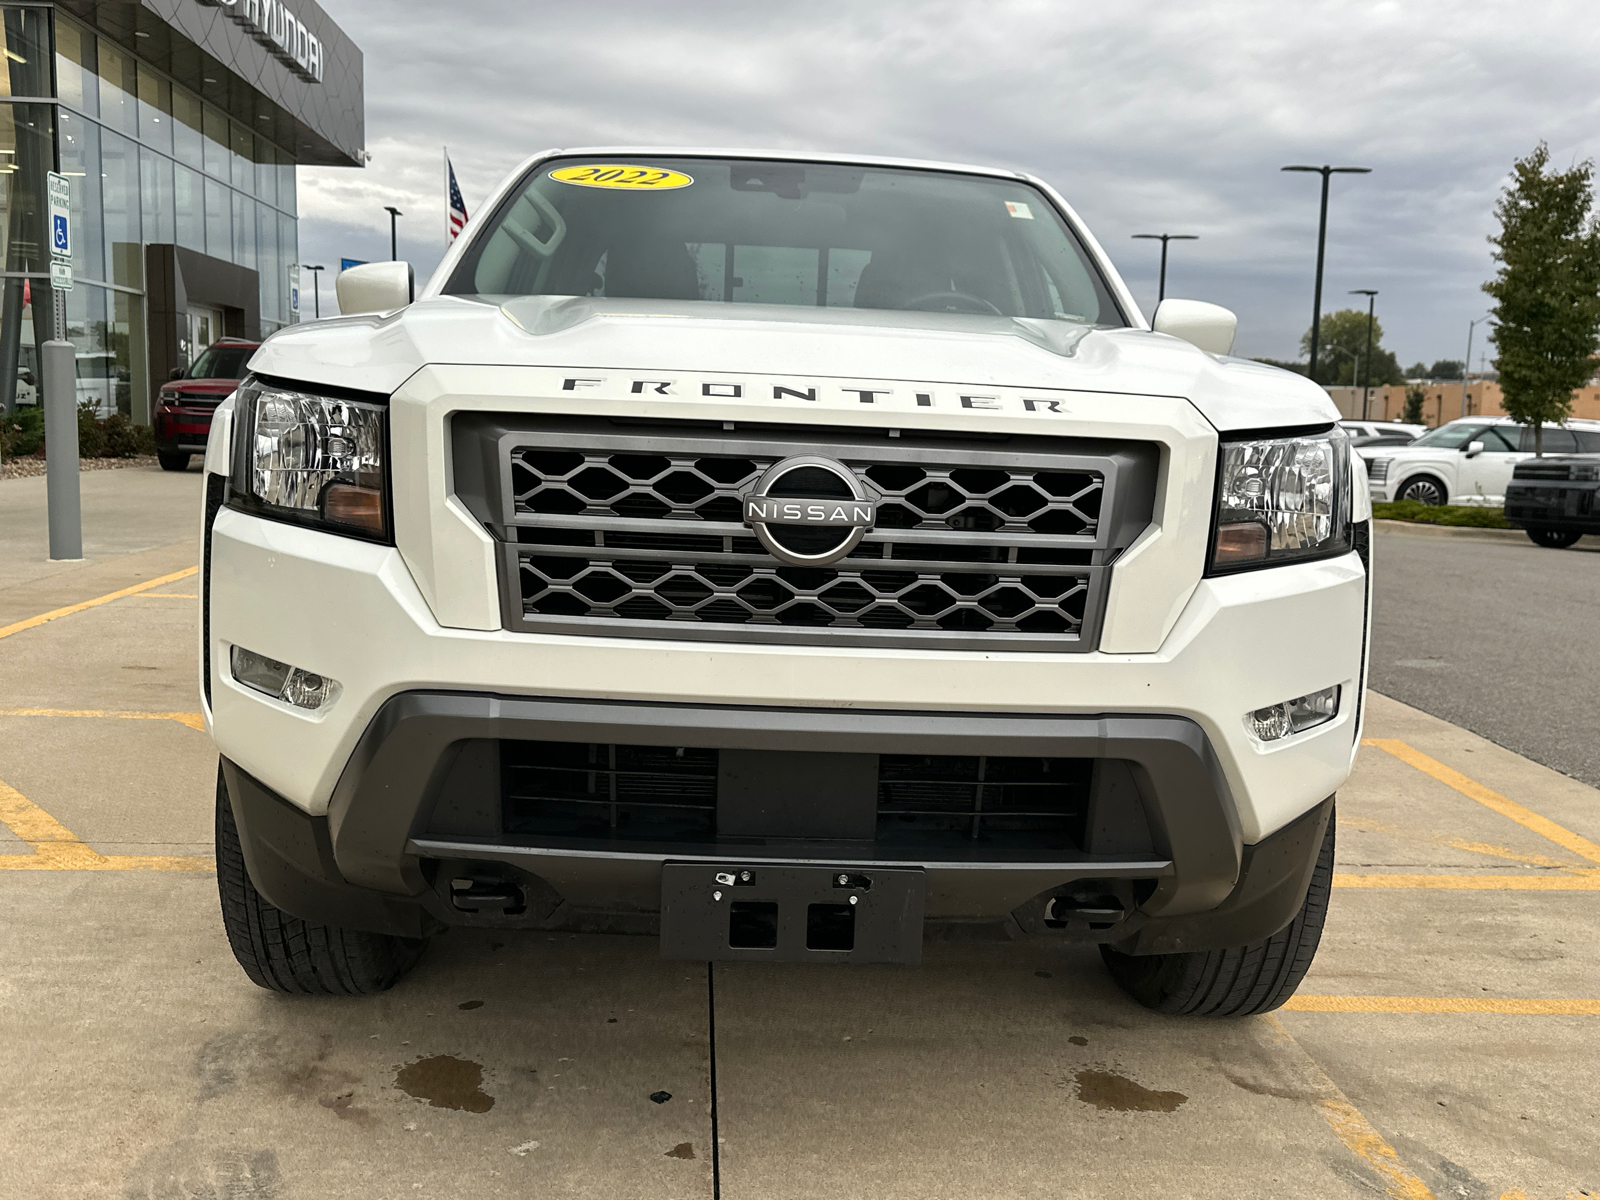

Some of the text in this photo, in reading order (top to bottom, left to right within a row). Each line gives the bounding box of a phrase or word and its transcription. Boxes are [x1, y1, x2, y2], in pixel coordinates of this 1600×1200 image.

[567, 168, 670, 185] 2022
[50, 180, 69, 196] RESERVED
[50, 194, 69, 210] PARKING
[562, 378, 1064, 414] FRONTIER
[748, 502, 871, 522] NISSAN
